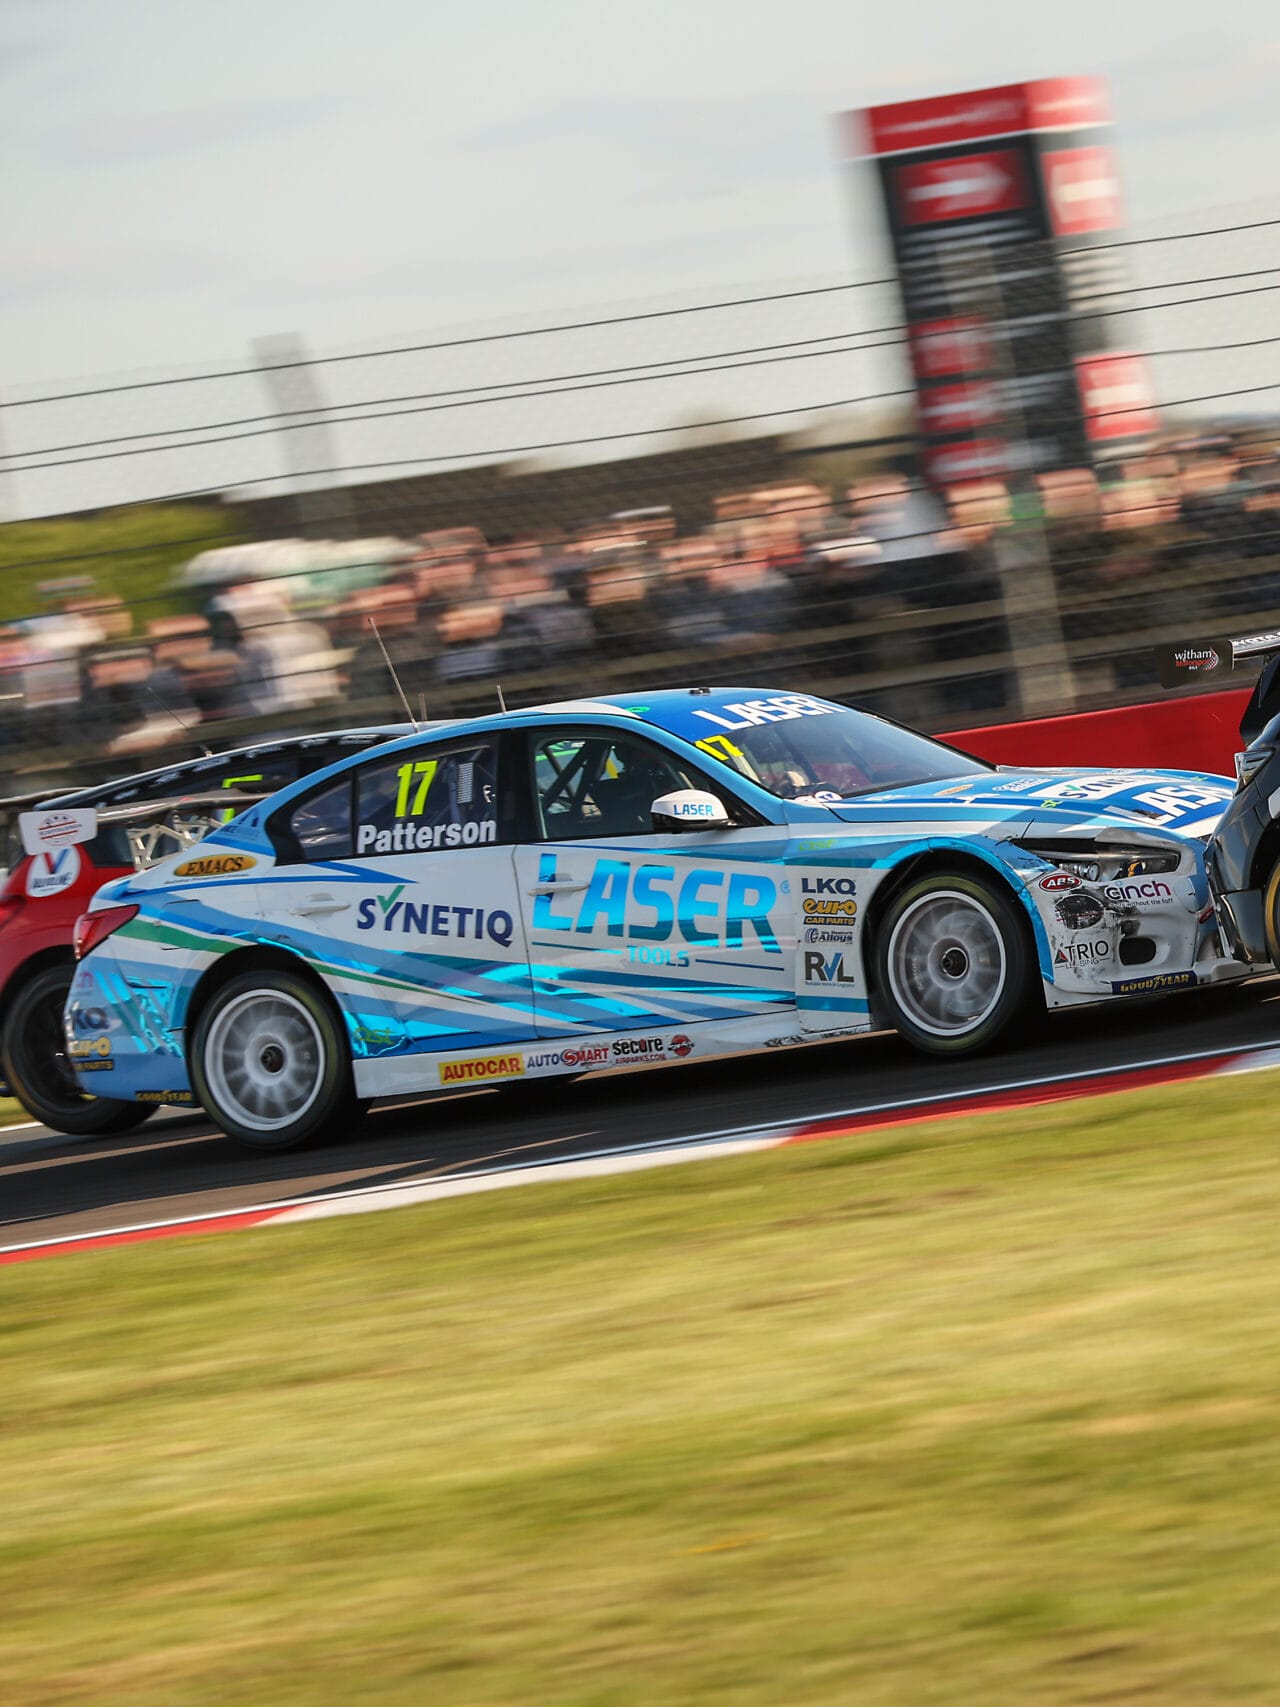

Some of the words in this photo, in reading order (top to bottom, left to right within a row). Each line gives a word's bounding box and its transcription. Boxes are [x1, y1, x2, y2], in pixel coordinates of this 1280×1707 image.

[691, 695, 847, 730] LASER
[695, 735, 744, 761] 17
[394, 760, 438, 818] 17
[673, 803, 714, 817] LASER
[357, 819, 497, 854] Patterson
[186, 856, 245, 876] EMACS
[802, 878, 857, 896] LKQ
[1047, 876, 1076, 888] ABS
[1106, 880, 1172, 900] cinch
[533, 853, 783, 954] LASER
[803, 898, 858, 915] euro
[357, 885, 513, 948] SYNETIQ
[826, 917, 855, 926] PARTS
[818, 934, 853, 944] Alloys
[627, 945, 690, 968] TOOLS
[804, 951, 855, 983] RVL
[1120, 973, 1190, 992] GOODYEAR
[612, 1037, 663, 1056] secure
[443, 1057, 521, 1081] AUTOCAR
